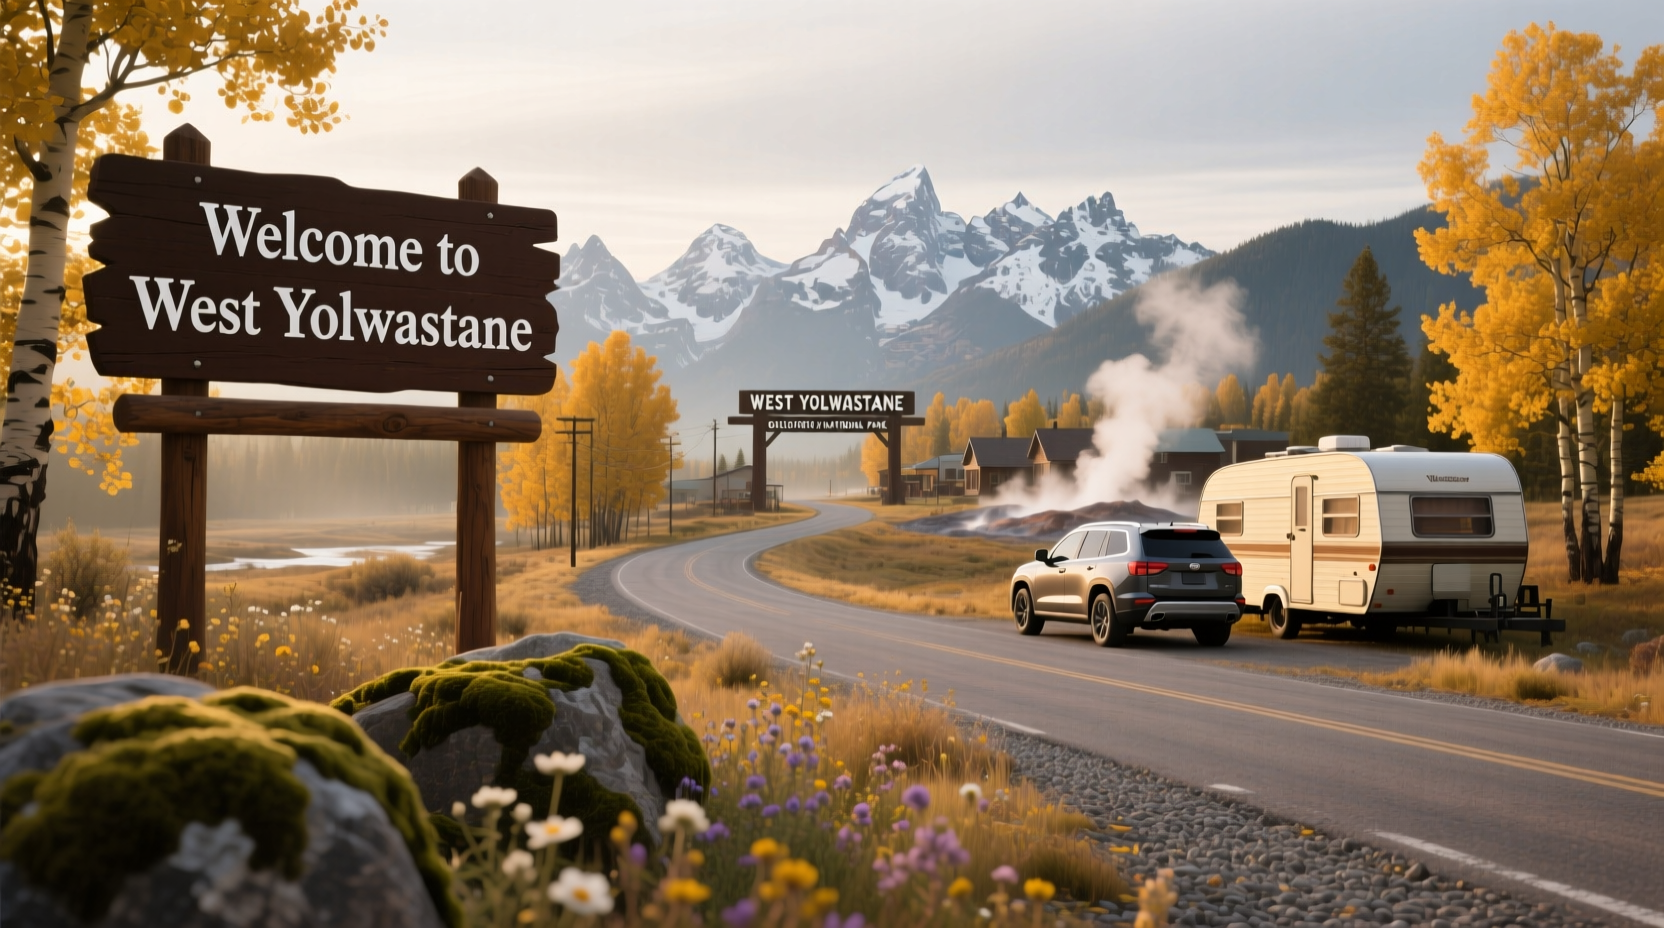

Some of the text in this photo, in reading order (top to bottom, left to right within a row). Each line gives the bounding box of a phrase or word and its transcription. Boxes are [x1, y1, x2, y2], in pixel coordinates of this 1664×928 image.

[199, 202, 480, 277] Welcome to
[128, 275, 533, 352] West Yolwastane
[750, 394, 904, 412] WEST YOLWASTANE
